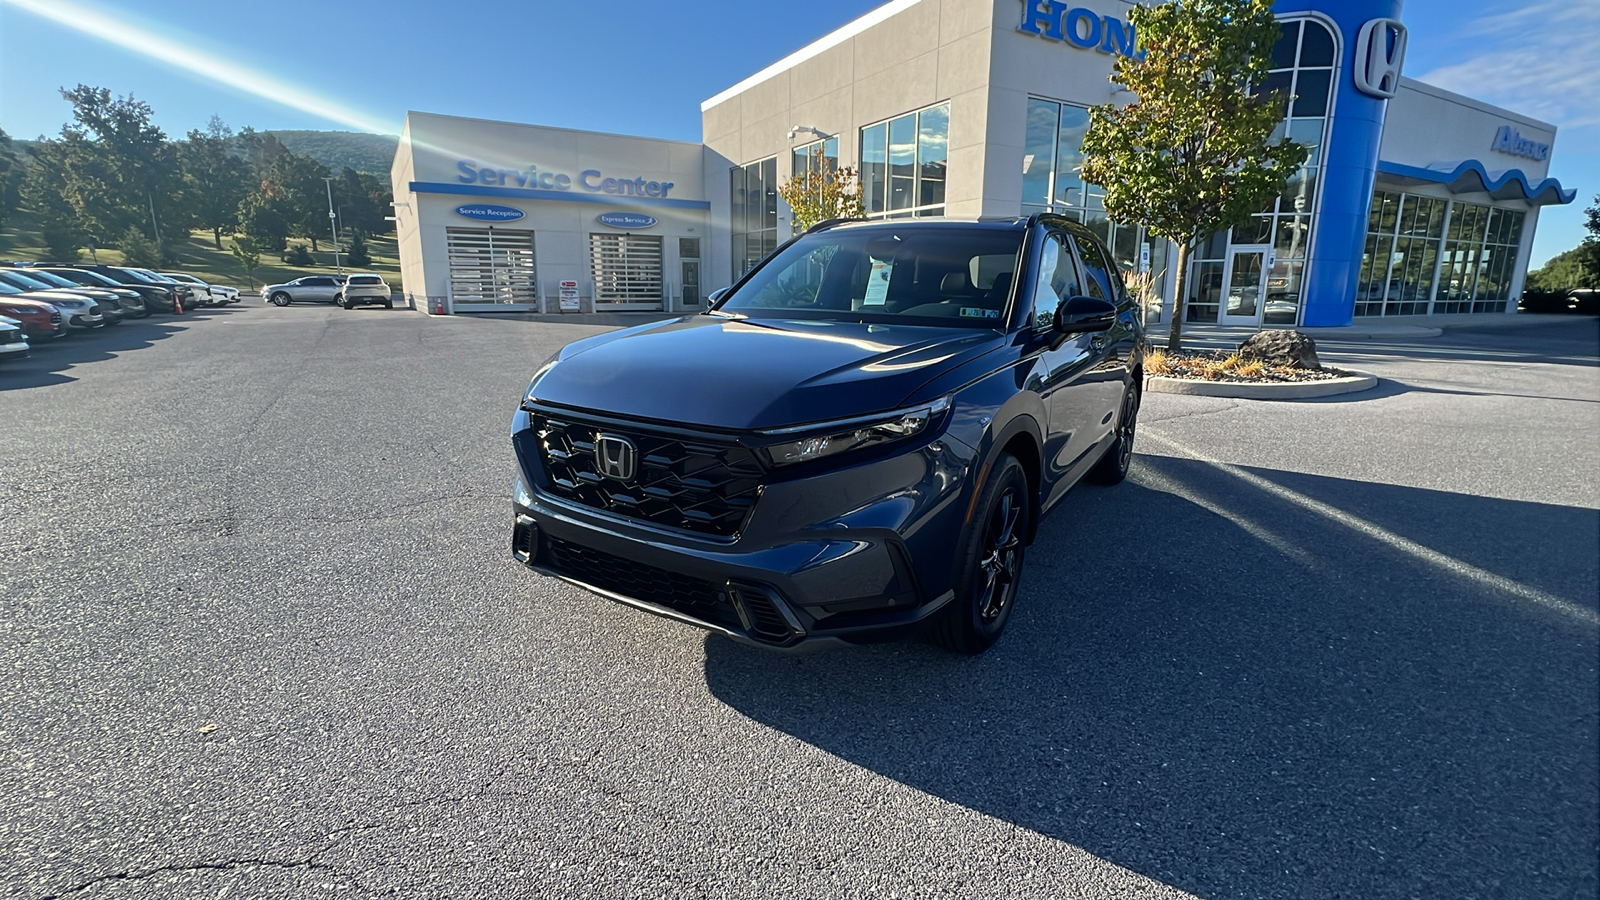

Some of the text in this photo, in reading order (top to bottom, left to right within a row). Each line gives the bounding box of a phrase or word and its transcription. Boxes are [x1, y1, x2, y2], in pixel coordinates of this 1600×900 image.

[1017, 0, 1147, 60] HON
[457, 159, 674, 198] Service Center
[459, 207, 522, 217] Service Reception
[601, 215, 646, 224] Express Service
